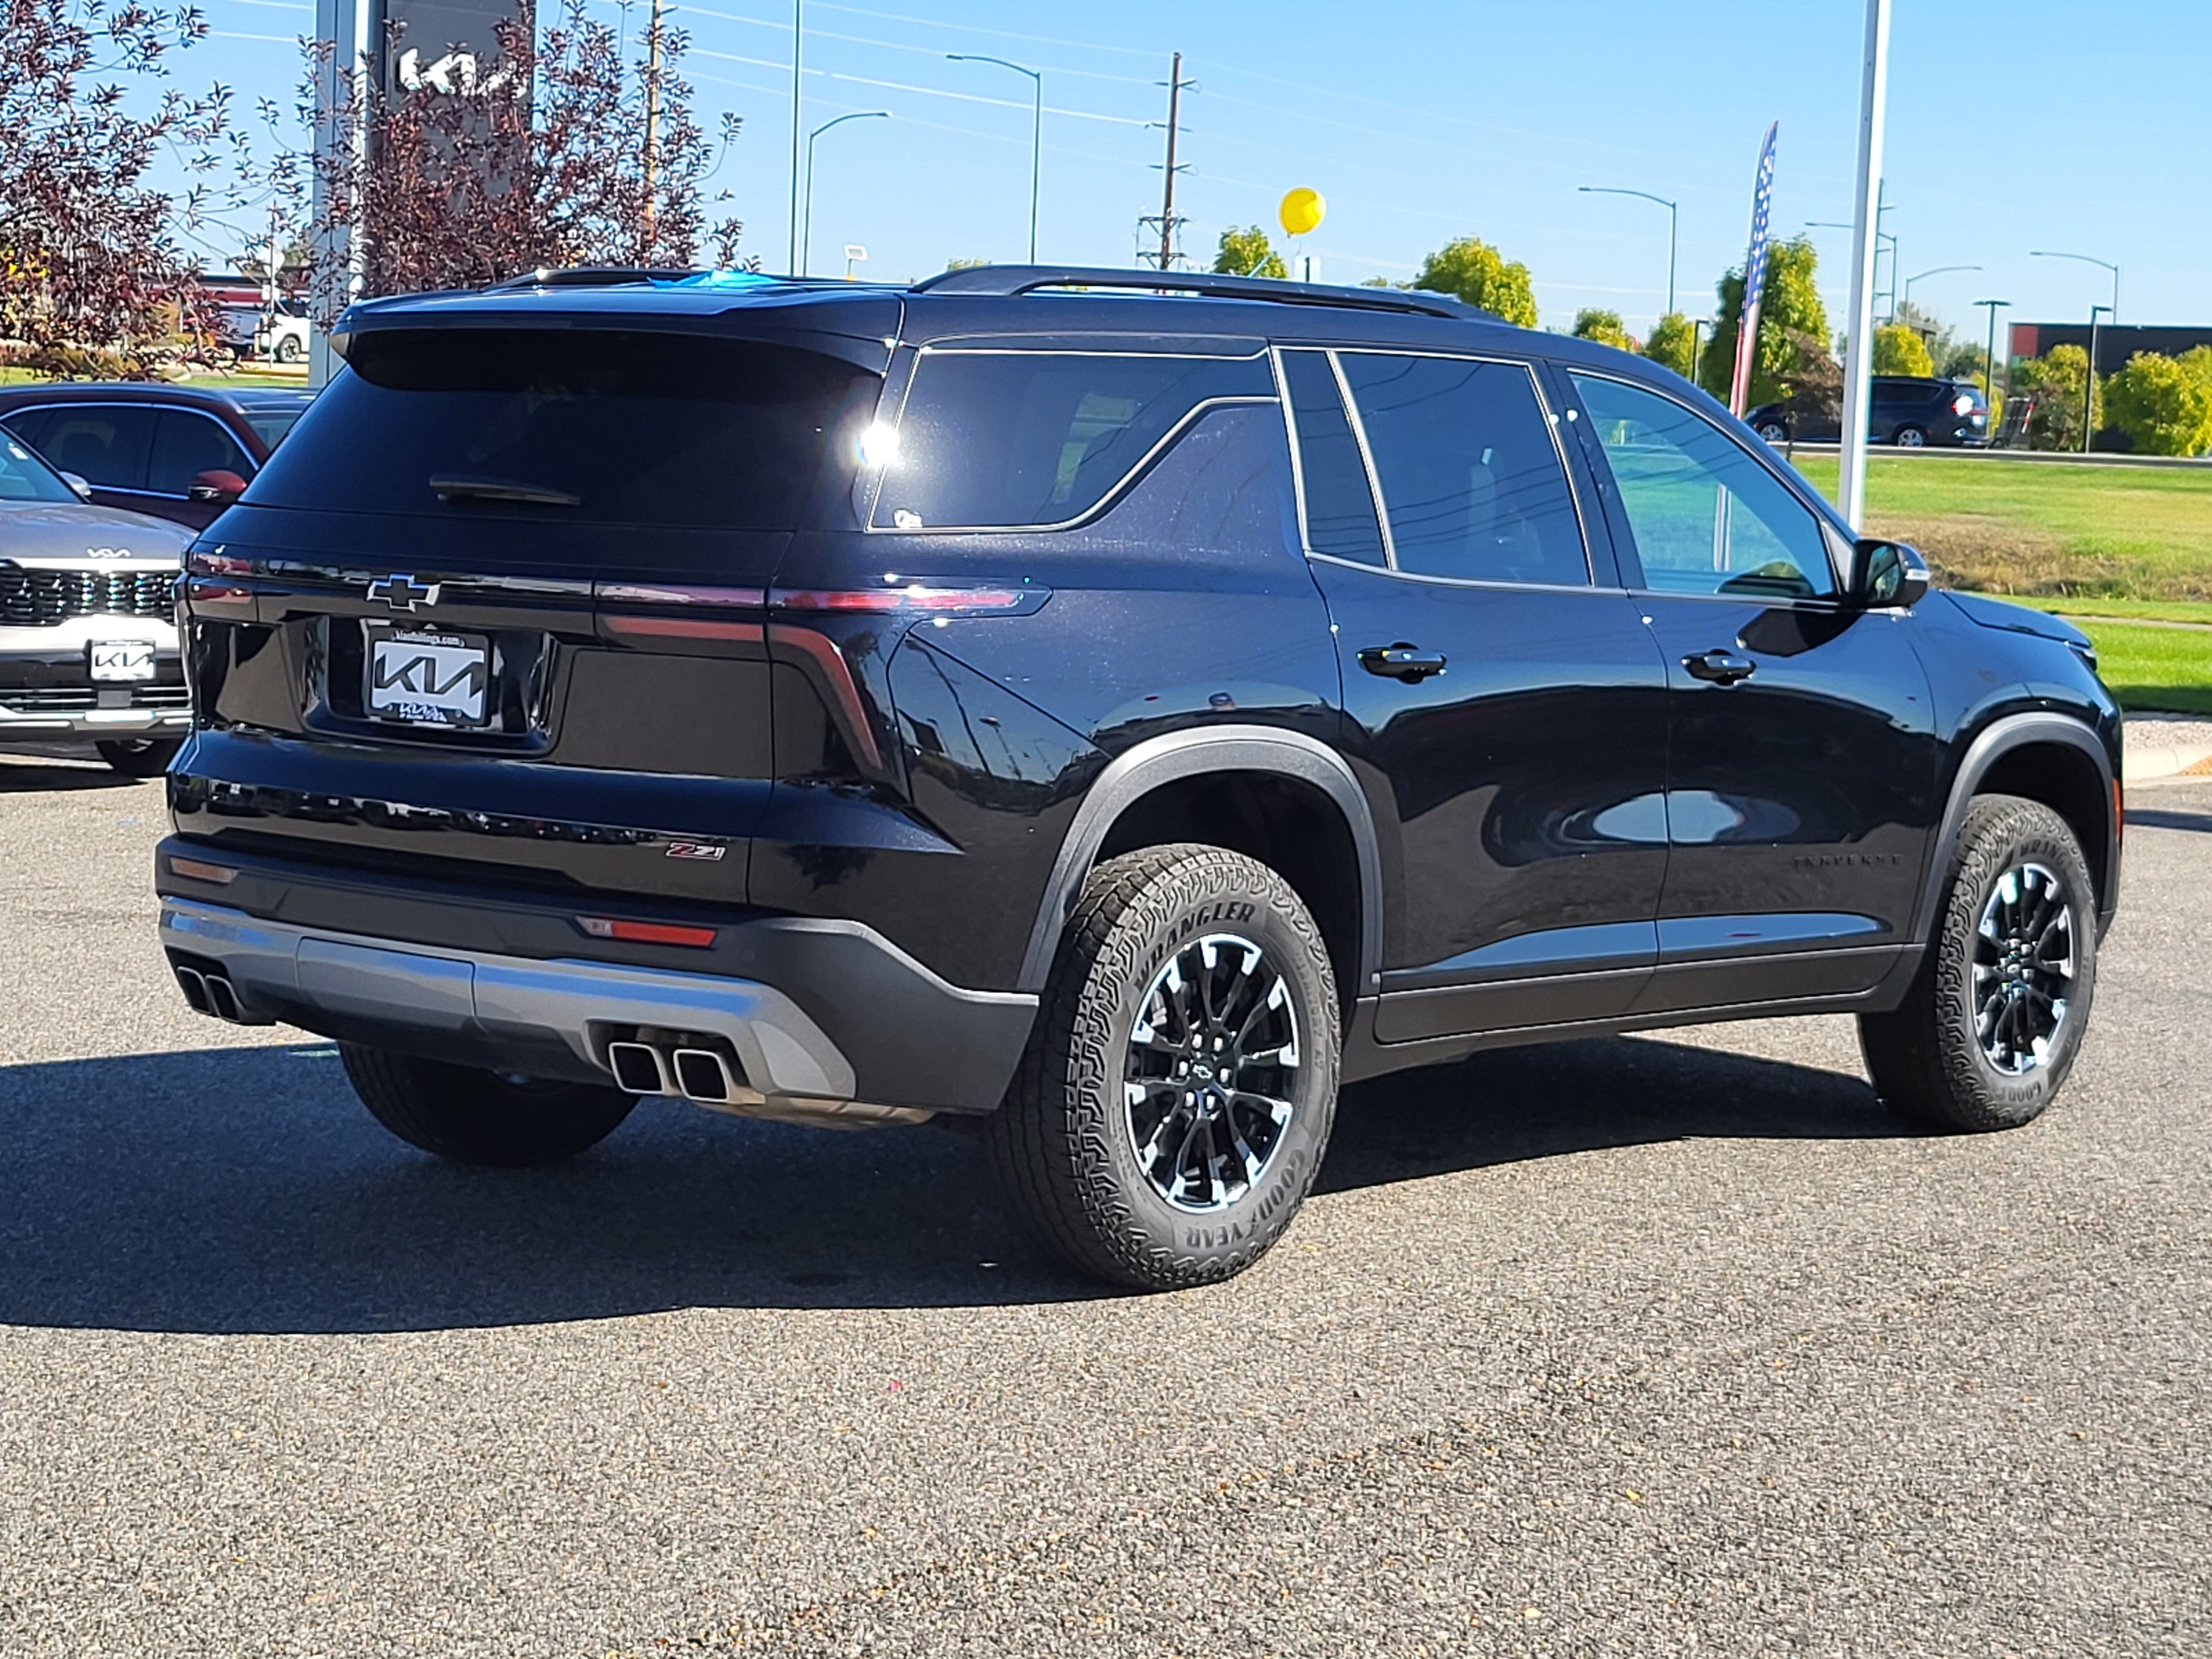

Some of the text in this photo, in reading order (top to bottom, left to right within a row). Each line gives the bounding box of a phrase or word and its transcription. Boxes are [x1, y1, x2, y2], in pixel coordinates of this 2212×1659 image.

[95, 652, 155, 667] KIA
[374, 653, 483, 699] KIA
[1134, 901, 1256, 993] WRANGLER
